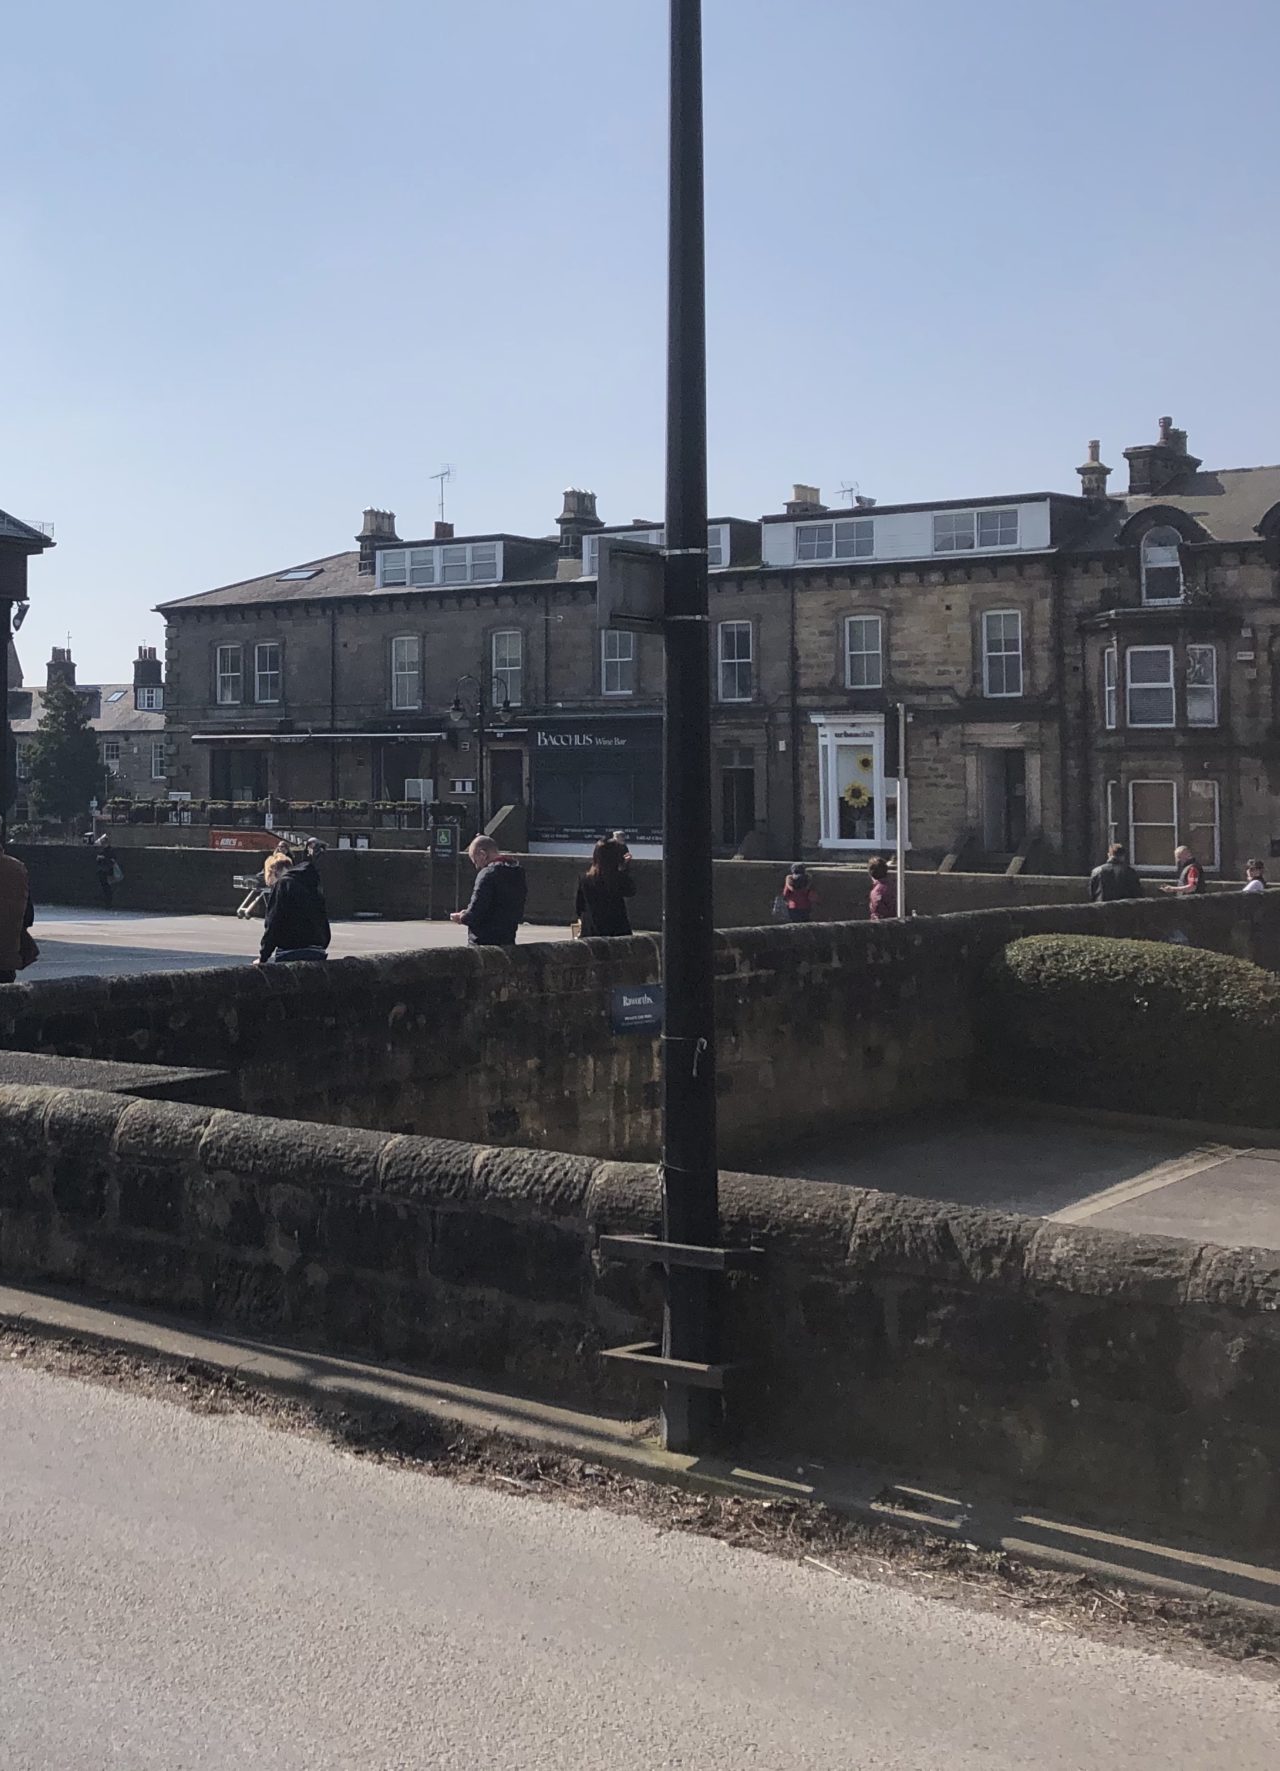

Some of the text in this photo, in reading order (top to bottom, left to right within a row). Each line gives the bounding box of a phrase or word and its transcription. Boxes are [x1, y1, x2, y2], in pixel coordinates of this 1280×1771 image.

[537, 731, 627, 746] BACCHUS Wine Bar
